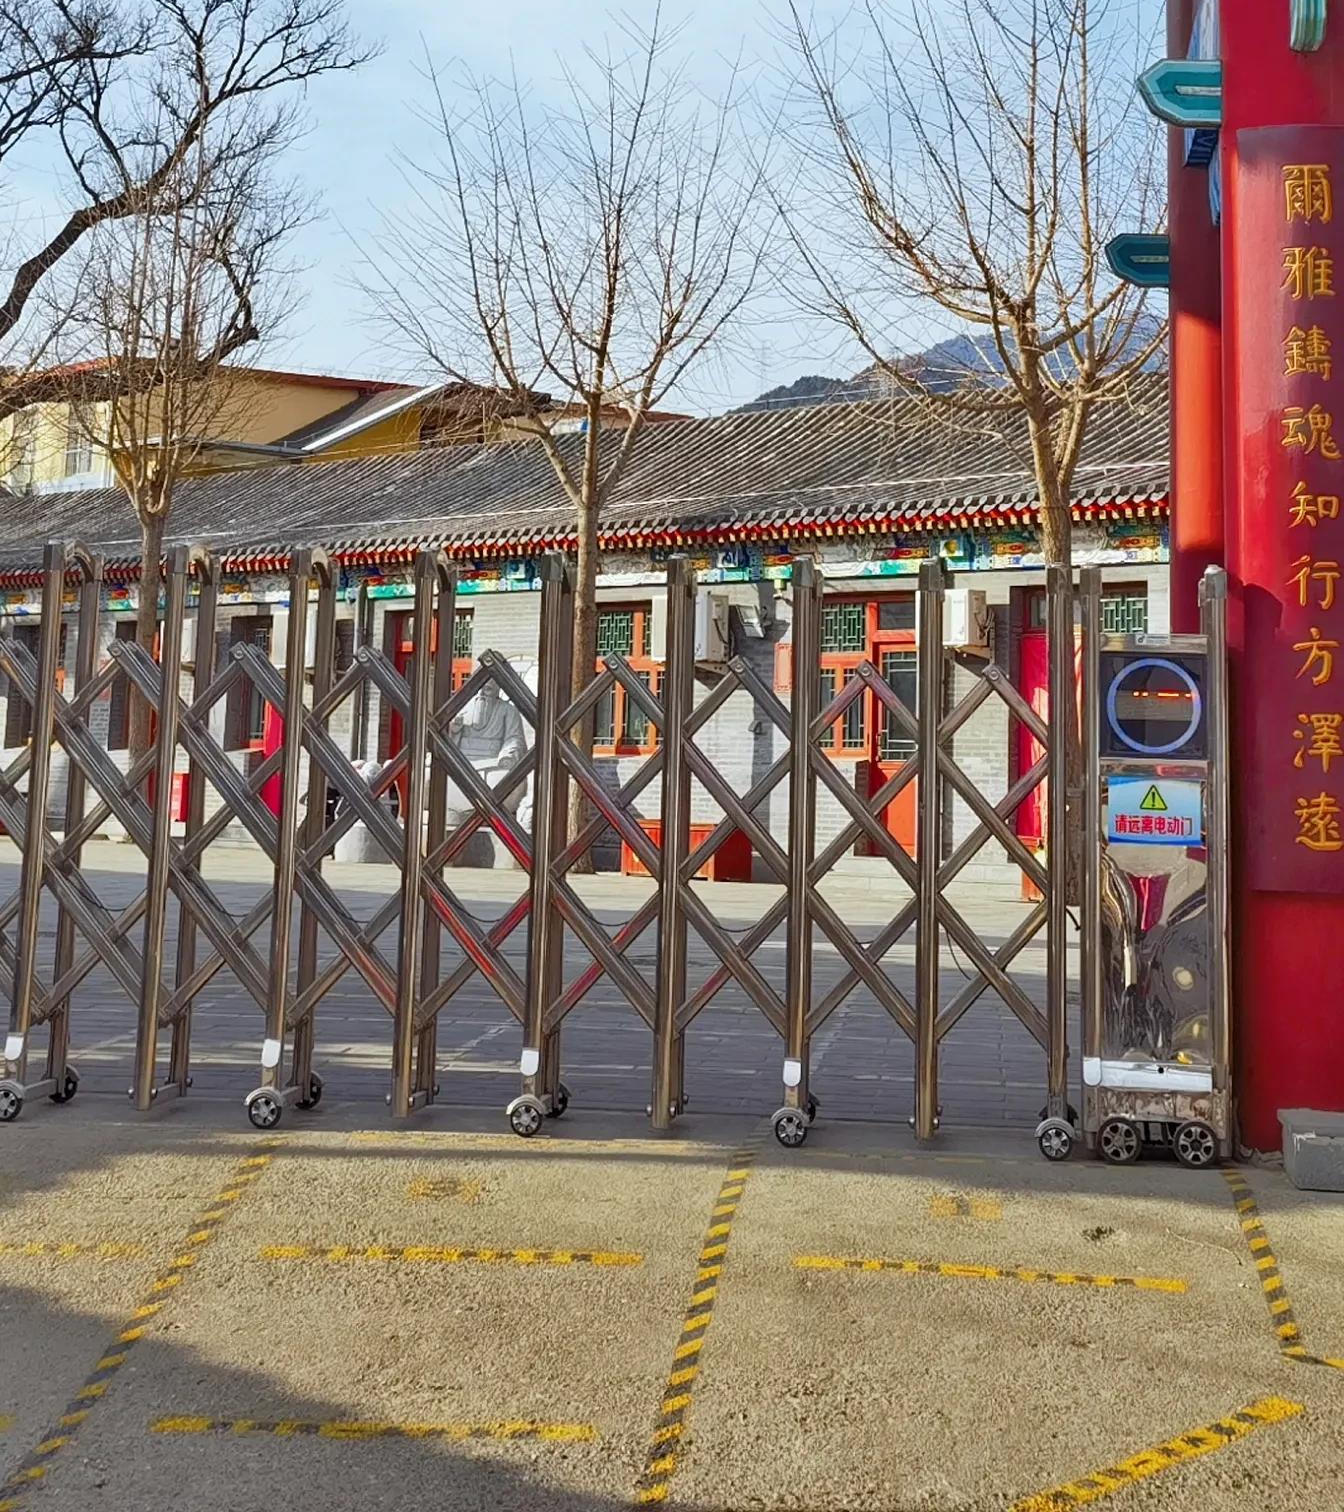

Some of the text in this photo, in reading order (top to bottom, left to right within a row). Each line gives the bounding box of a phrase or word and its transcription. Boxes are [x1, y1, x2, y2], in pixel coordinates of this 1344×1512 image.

[1280, 163, 1344, 853] 爾雅鑄魂知行方澤遠
[1115, 814, 1192, 836] 请远离电动门
